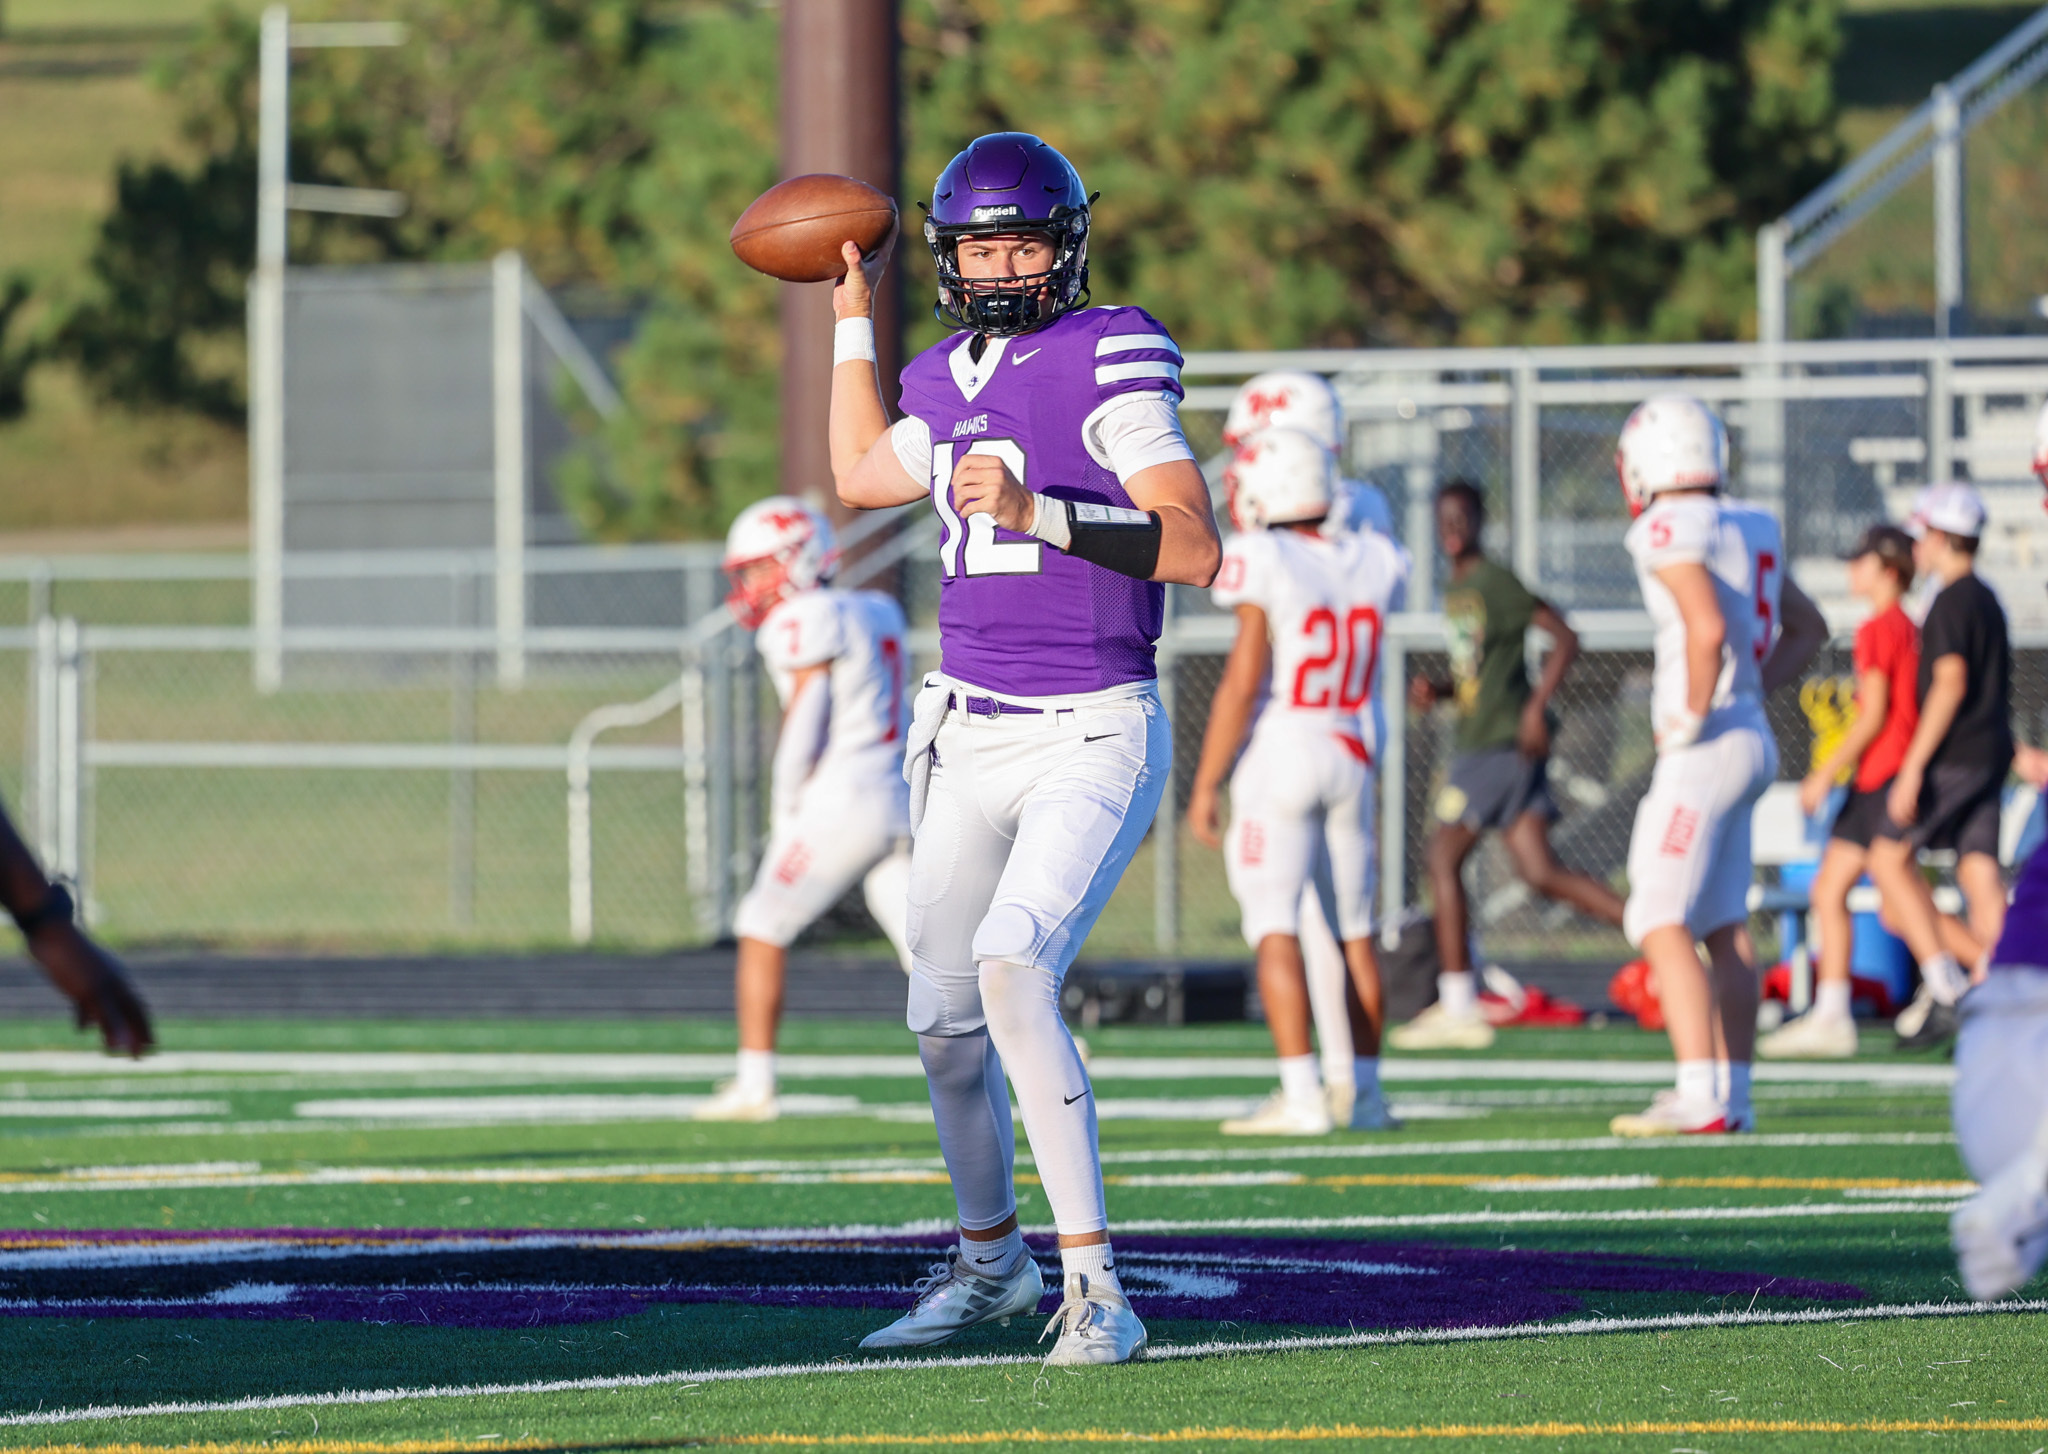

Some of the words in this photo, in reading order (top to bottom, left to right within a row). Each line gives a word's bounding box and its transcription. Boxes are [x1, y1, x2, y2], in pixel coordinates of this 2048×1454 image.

[975, 206, 1017, 218] Riddell
[952, 414, 988, 438] HAWKS
[931, 437, 1043, 579] 12
[1650, 513, 1674, 549] 5
[1213, 554, 1246, 592] 0
[1754, 550, 1777, 662] 5
[1292, 606, 1384, 712] 20
